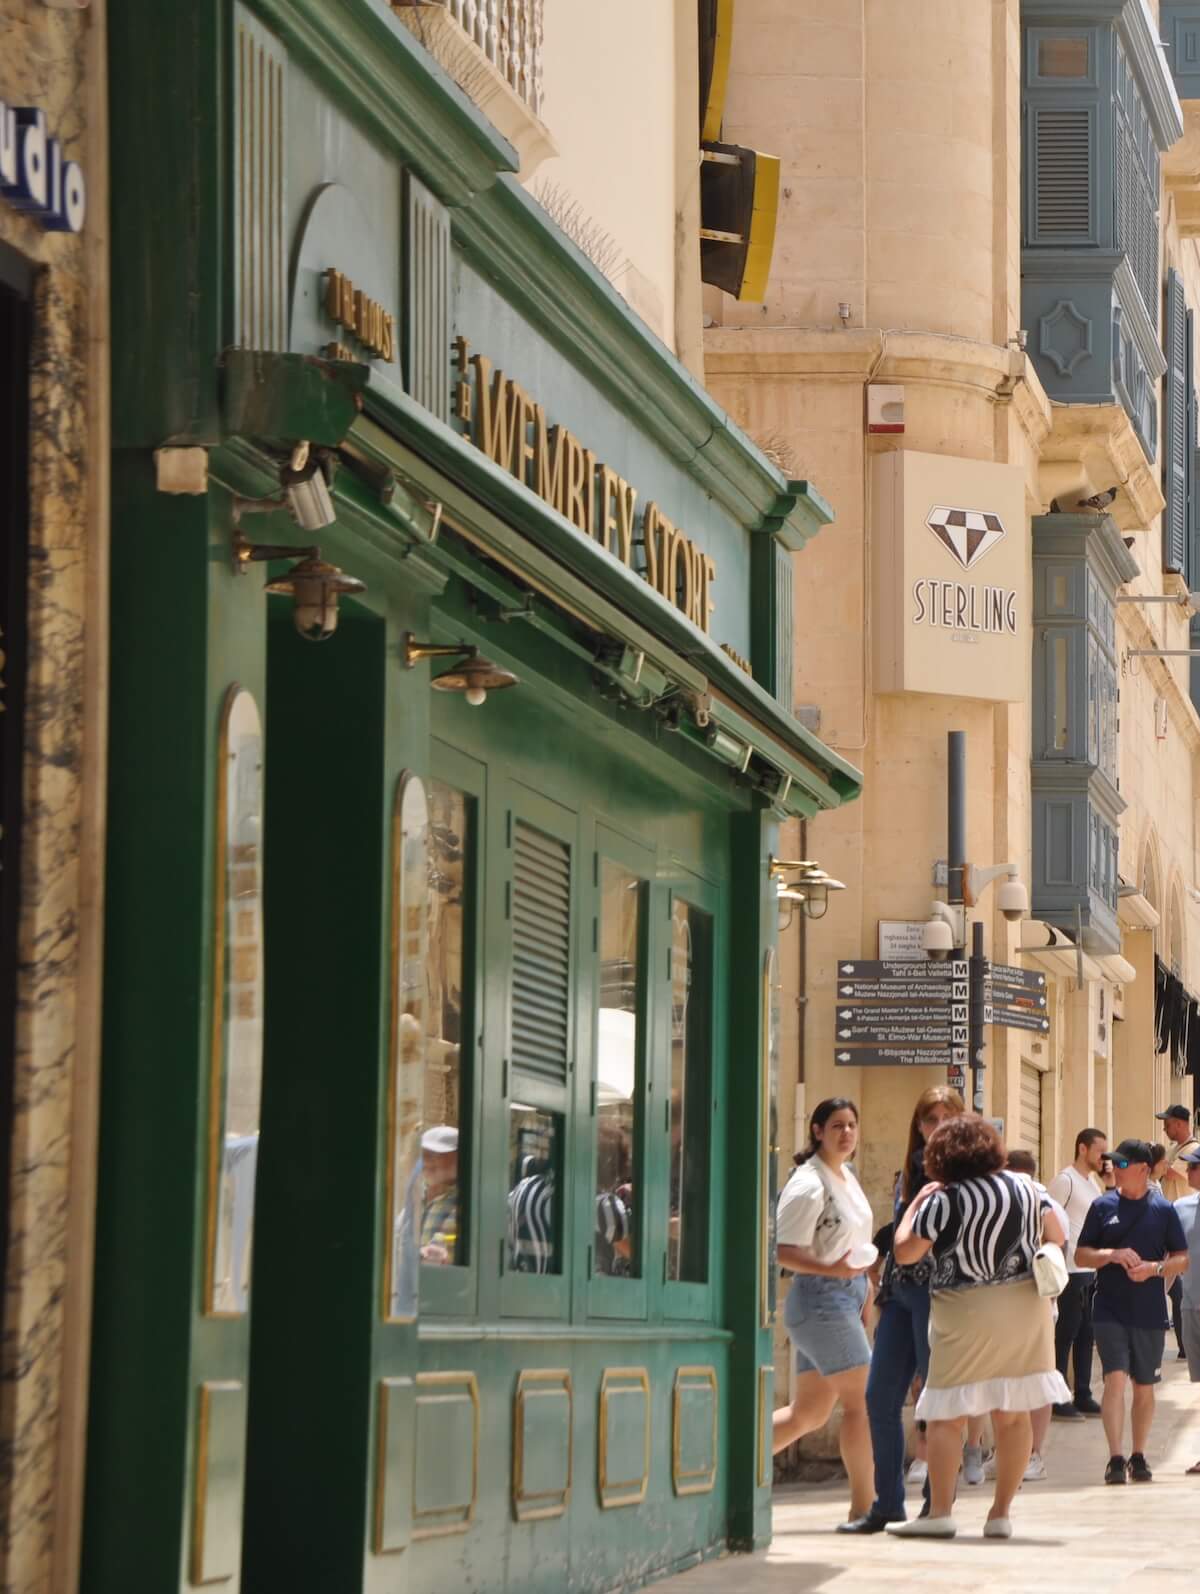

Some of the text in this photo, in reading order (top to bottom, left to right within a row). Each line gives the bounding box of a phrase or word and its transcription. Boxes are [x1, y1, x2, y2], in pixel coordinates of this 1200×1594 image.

[473, 354, 637, 568] WEMBLEY
[645, 500, 716, 635] STORE
[914, 579, 1016, 634] STERLING
[883, 962, 926, 971] Underground
[927, 969, 952, 977] Valletta
[880, 983, 906, 991] Museum
[914, 983, 951, 992] Archaeology
[922, 1033, 951, 1041] Museum
